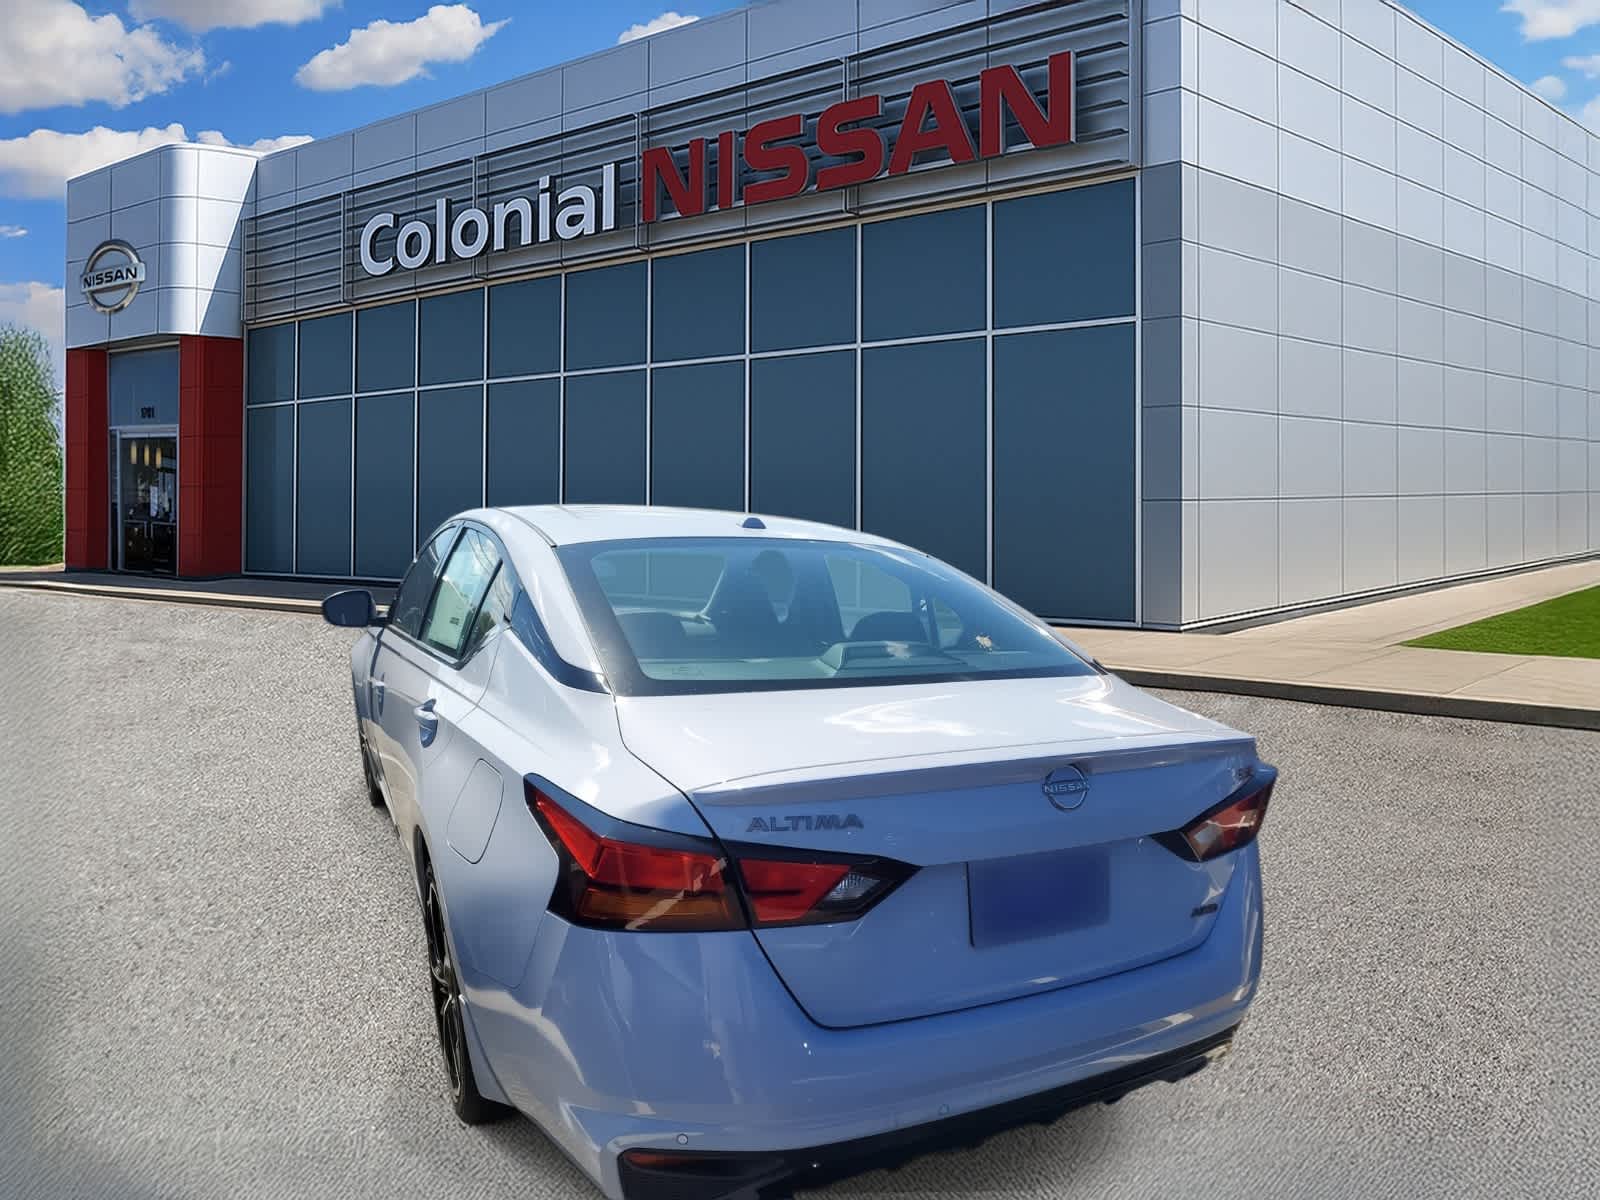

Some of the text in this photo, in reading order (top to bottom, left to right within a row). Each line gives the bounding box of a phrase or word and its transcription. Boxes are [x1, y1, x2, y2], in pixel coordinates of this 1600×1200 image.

[359, 51, 1076, 276] Colonial NISSAN
[83, 266, 138, 289] NISSAN
[746, 813, 864, 832] ALTIMA
